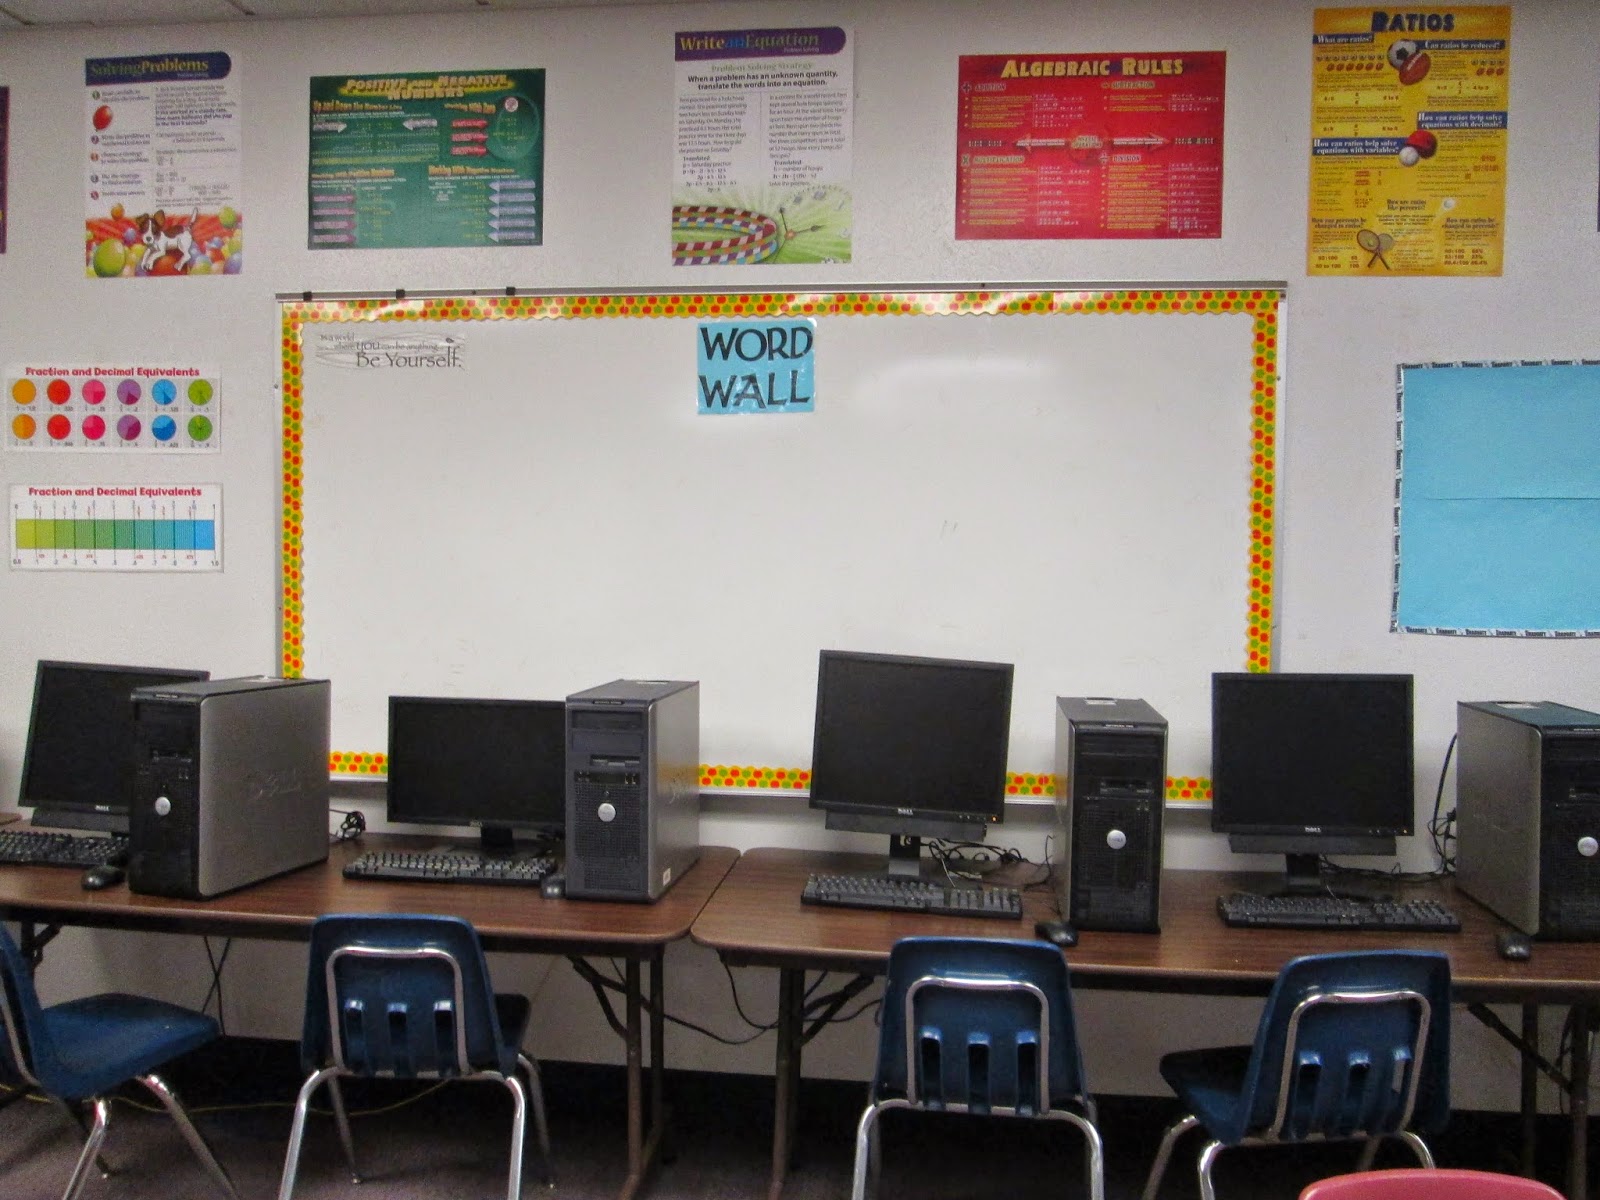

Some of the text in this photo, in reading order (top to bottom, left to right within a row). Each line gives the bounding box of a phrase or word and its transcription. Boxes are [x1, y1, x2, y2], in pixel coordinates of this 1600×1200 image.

[1371, 12, 1455, 32] RATIOS
[715, 74, 746, 83] problem
[806, 70, 838, 80] quantity,
[1001, 59, 1183, 78] ALGEBRAIC RULES
[793, 79, 828, 88] equation.
[700, 327, 813, 361] WORD
[357, 345, 462, 367] Be Yourself.
[26, 367, 200, 378] Fraction and Decimal Equivalents
[698, 370, 810, 409] WALL
[29, 487, 201, 498] Fraction and Decimal Equivalents
